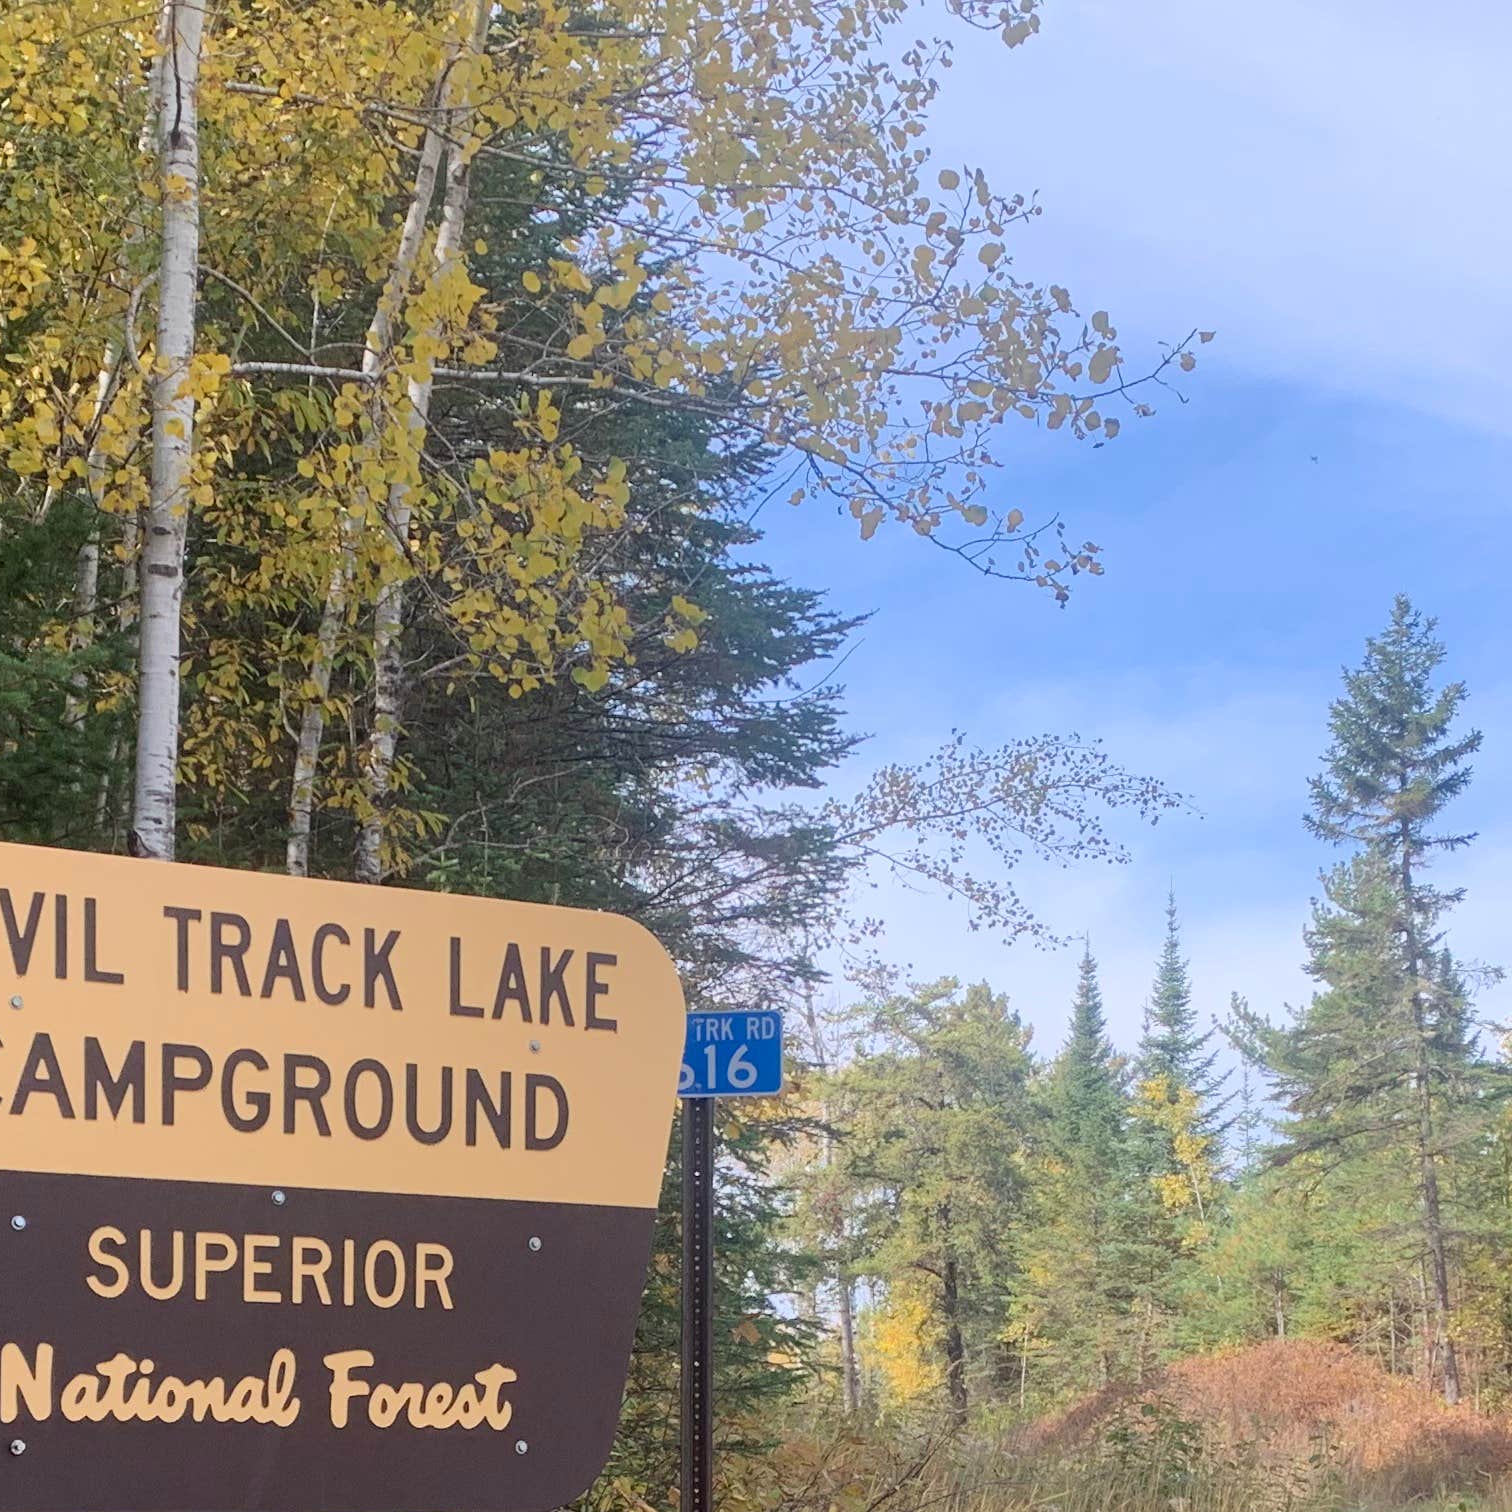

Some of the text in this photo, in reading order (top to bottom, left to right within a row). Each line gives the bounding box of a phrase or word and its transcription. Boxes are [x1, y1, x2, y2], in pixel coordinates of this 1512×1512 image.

[163, 904, 403, 1012] TRACK
[448, 935, 619, 1033] LAKE
[692, 1015, 775, 1042] TRK RD
[85, 1225, 455, 1310] SUPERIOR
[0, 1342, 517, 1431] National Forest
